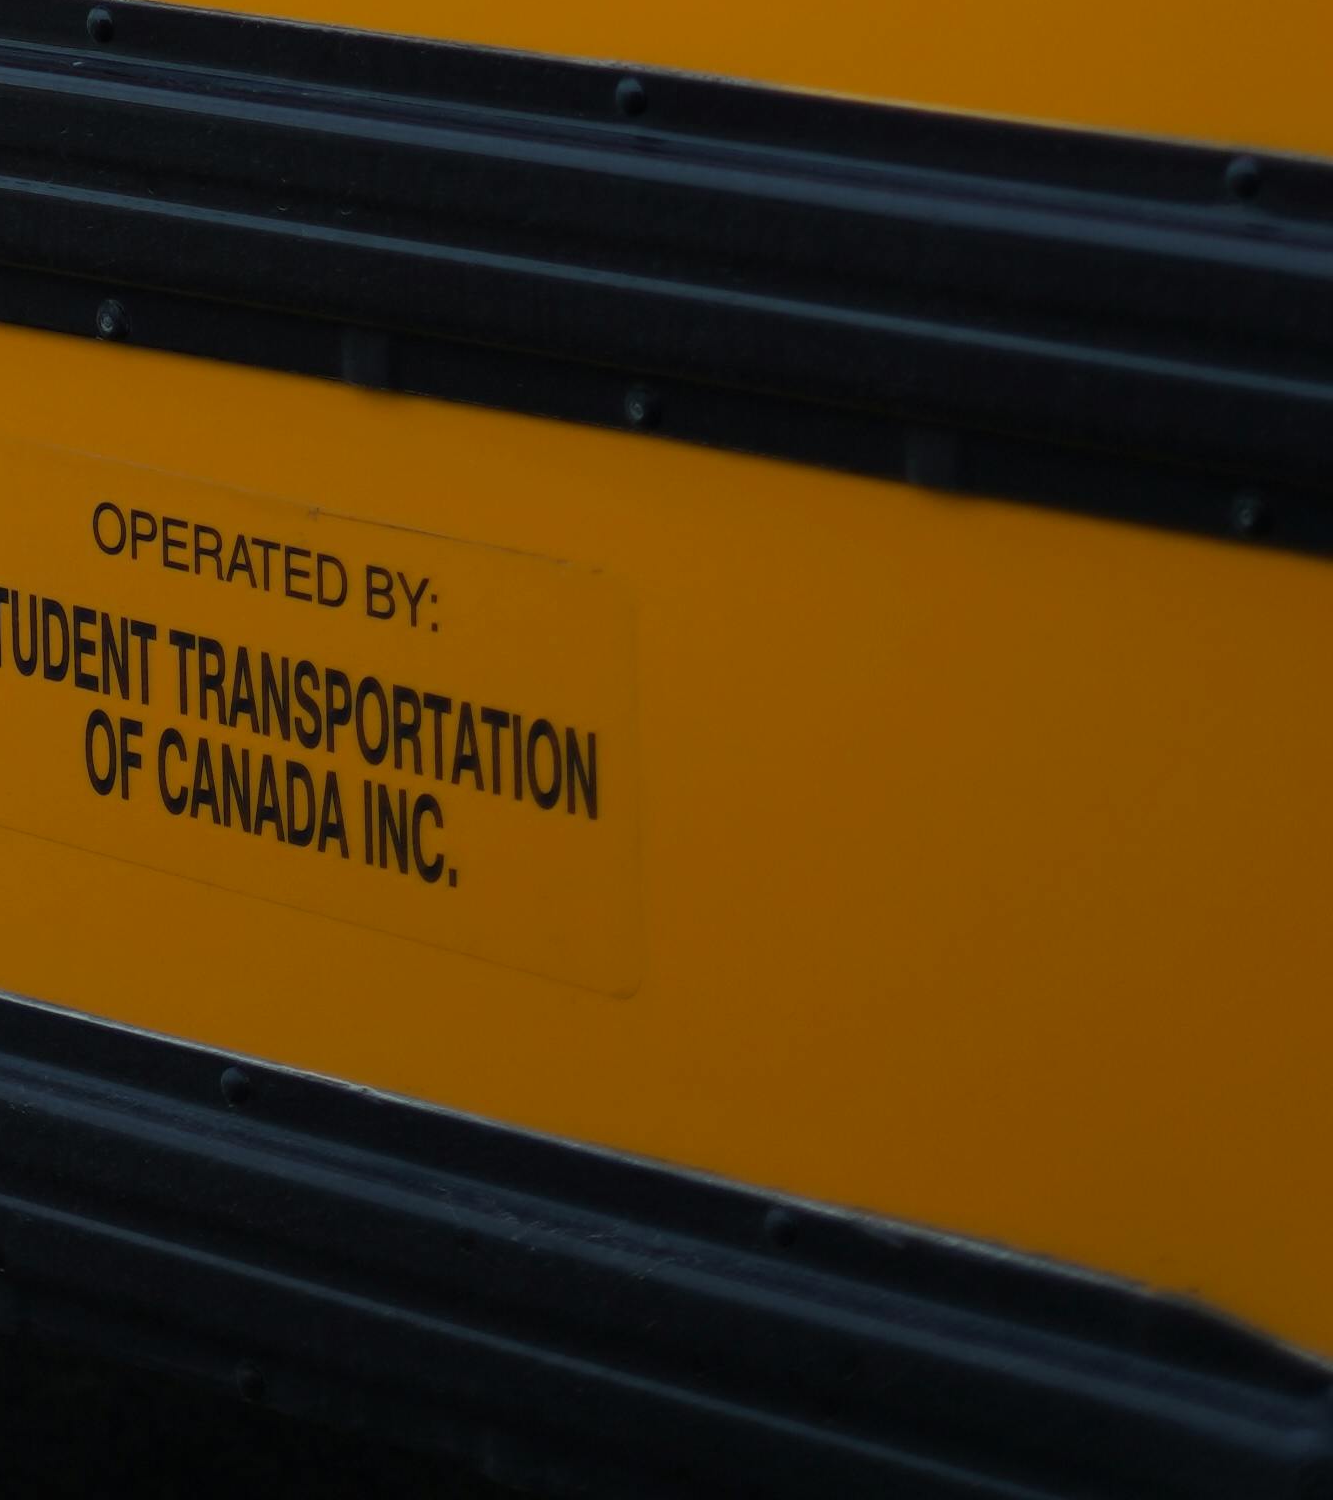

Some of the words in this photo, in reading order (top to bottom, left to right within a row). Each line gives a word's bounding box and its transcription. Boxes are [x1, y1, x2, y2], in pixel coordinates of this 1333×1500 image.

[92, 501, 348, 608] OPERATED
[365, 564, 440, 632] BY:
[84, 708, 144, 801] OF
[157, 727, 350, 860] CANADA
[363, 780, 459, 888] INC.
[168, 628, 599, 821] TRANSPORTATION
